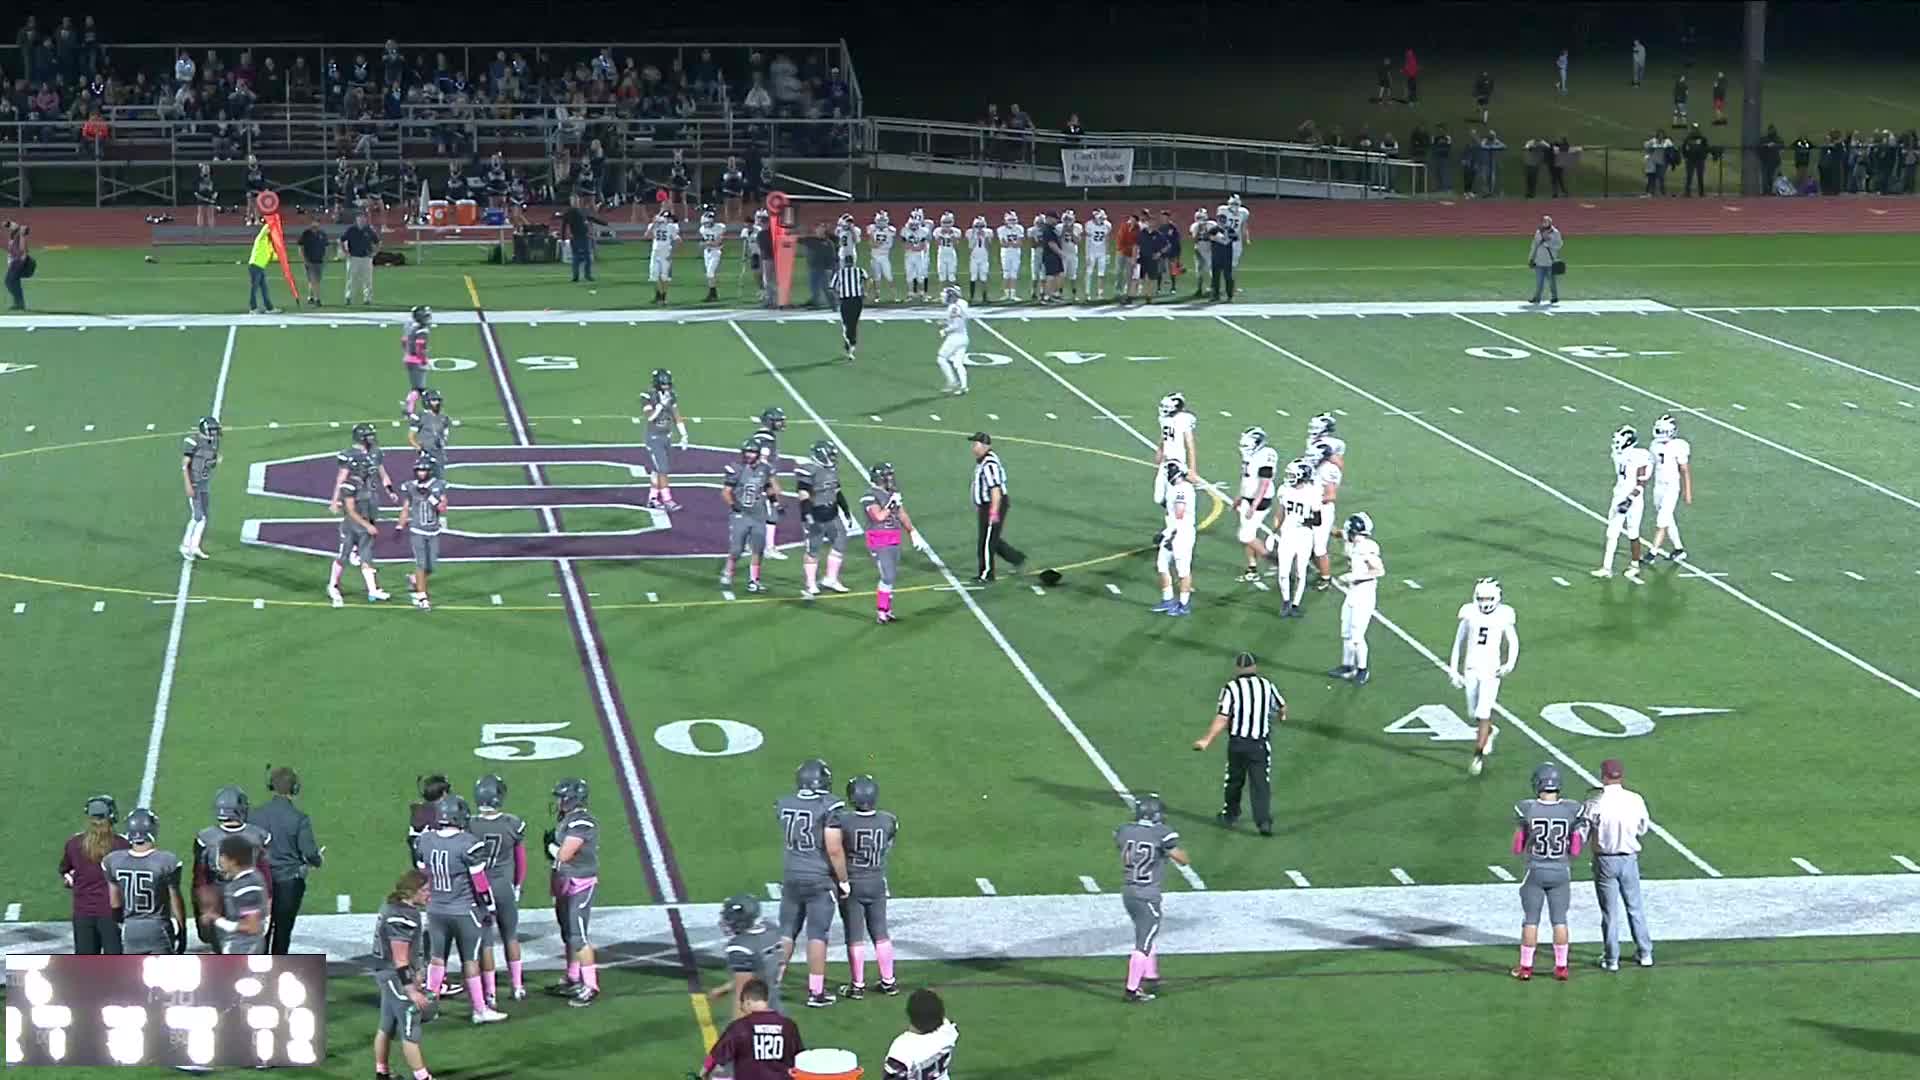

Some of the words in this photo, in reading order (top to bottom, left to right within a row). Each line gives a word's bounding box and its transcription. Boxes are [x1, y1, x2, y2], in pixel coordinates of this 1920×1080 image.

[1477, 626, 1489, 645] 5
[781, 808, 816, 851] 73
[853, 828, 883, 868] 51
[1532, 818, 1568, 859] 33
[430, 848, 452, 892] 11
[483, 833, 503, 869] 7
[116, 870, 155, 914] 75
